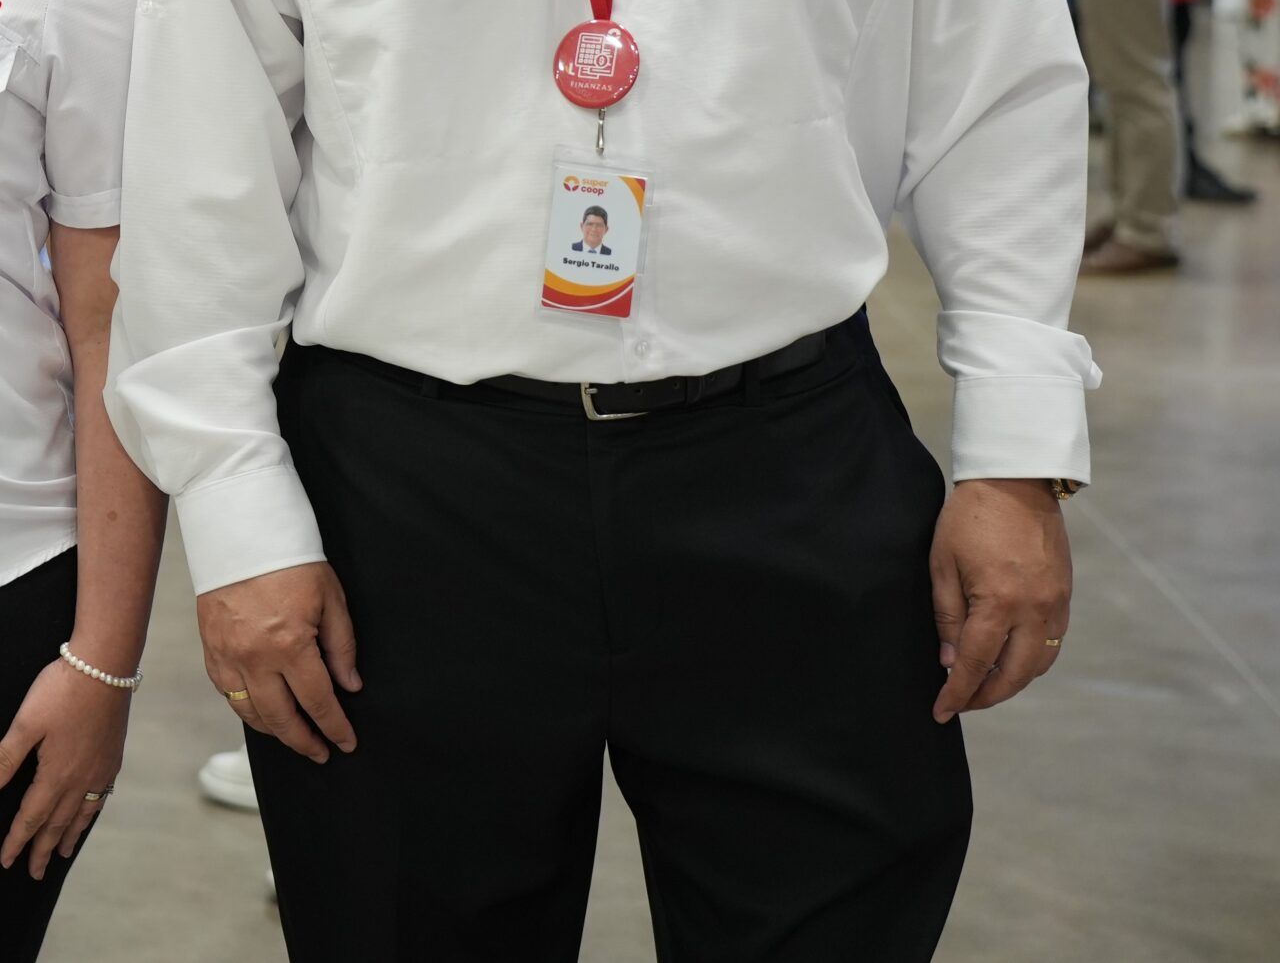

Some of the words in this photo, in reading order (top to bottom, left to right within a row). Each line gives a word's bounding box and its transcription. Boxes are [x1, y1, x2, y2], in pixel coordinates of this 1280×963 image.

[570, 80, 613, 92] FINANZAS
[581, 177, 609, 188] super
[580, 185, 605, 197] coop
